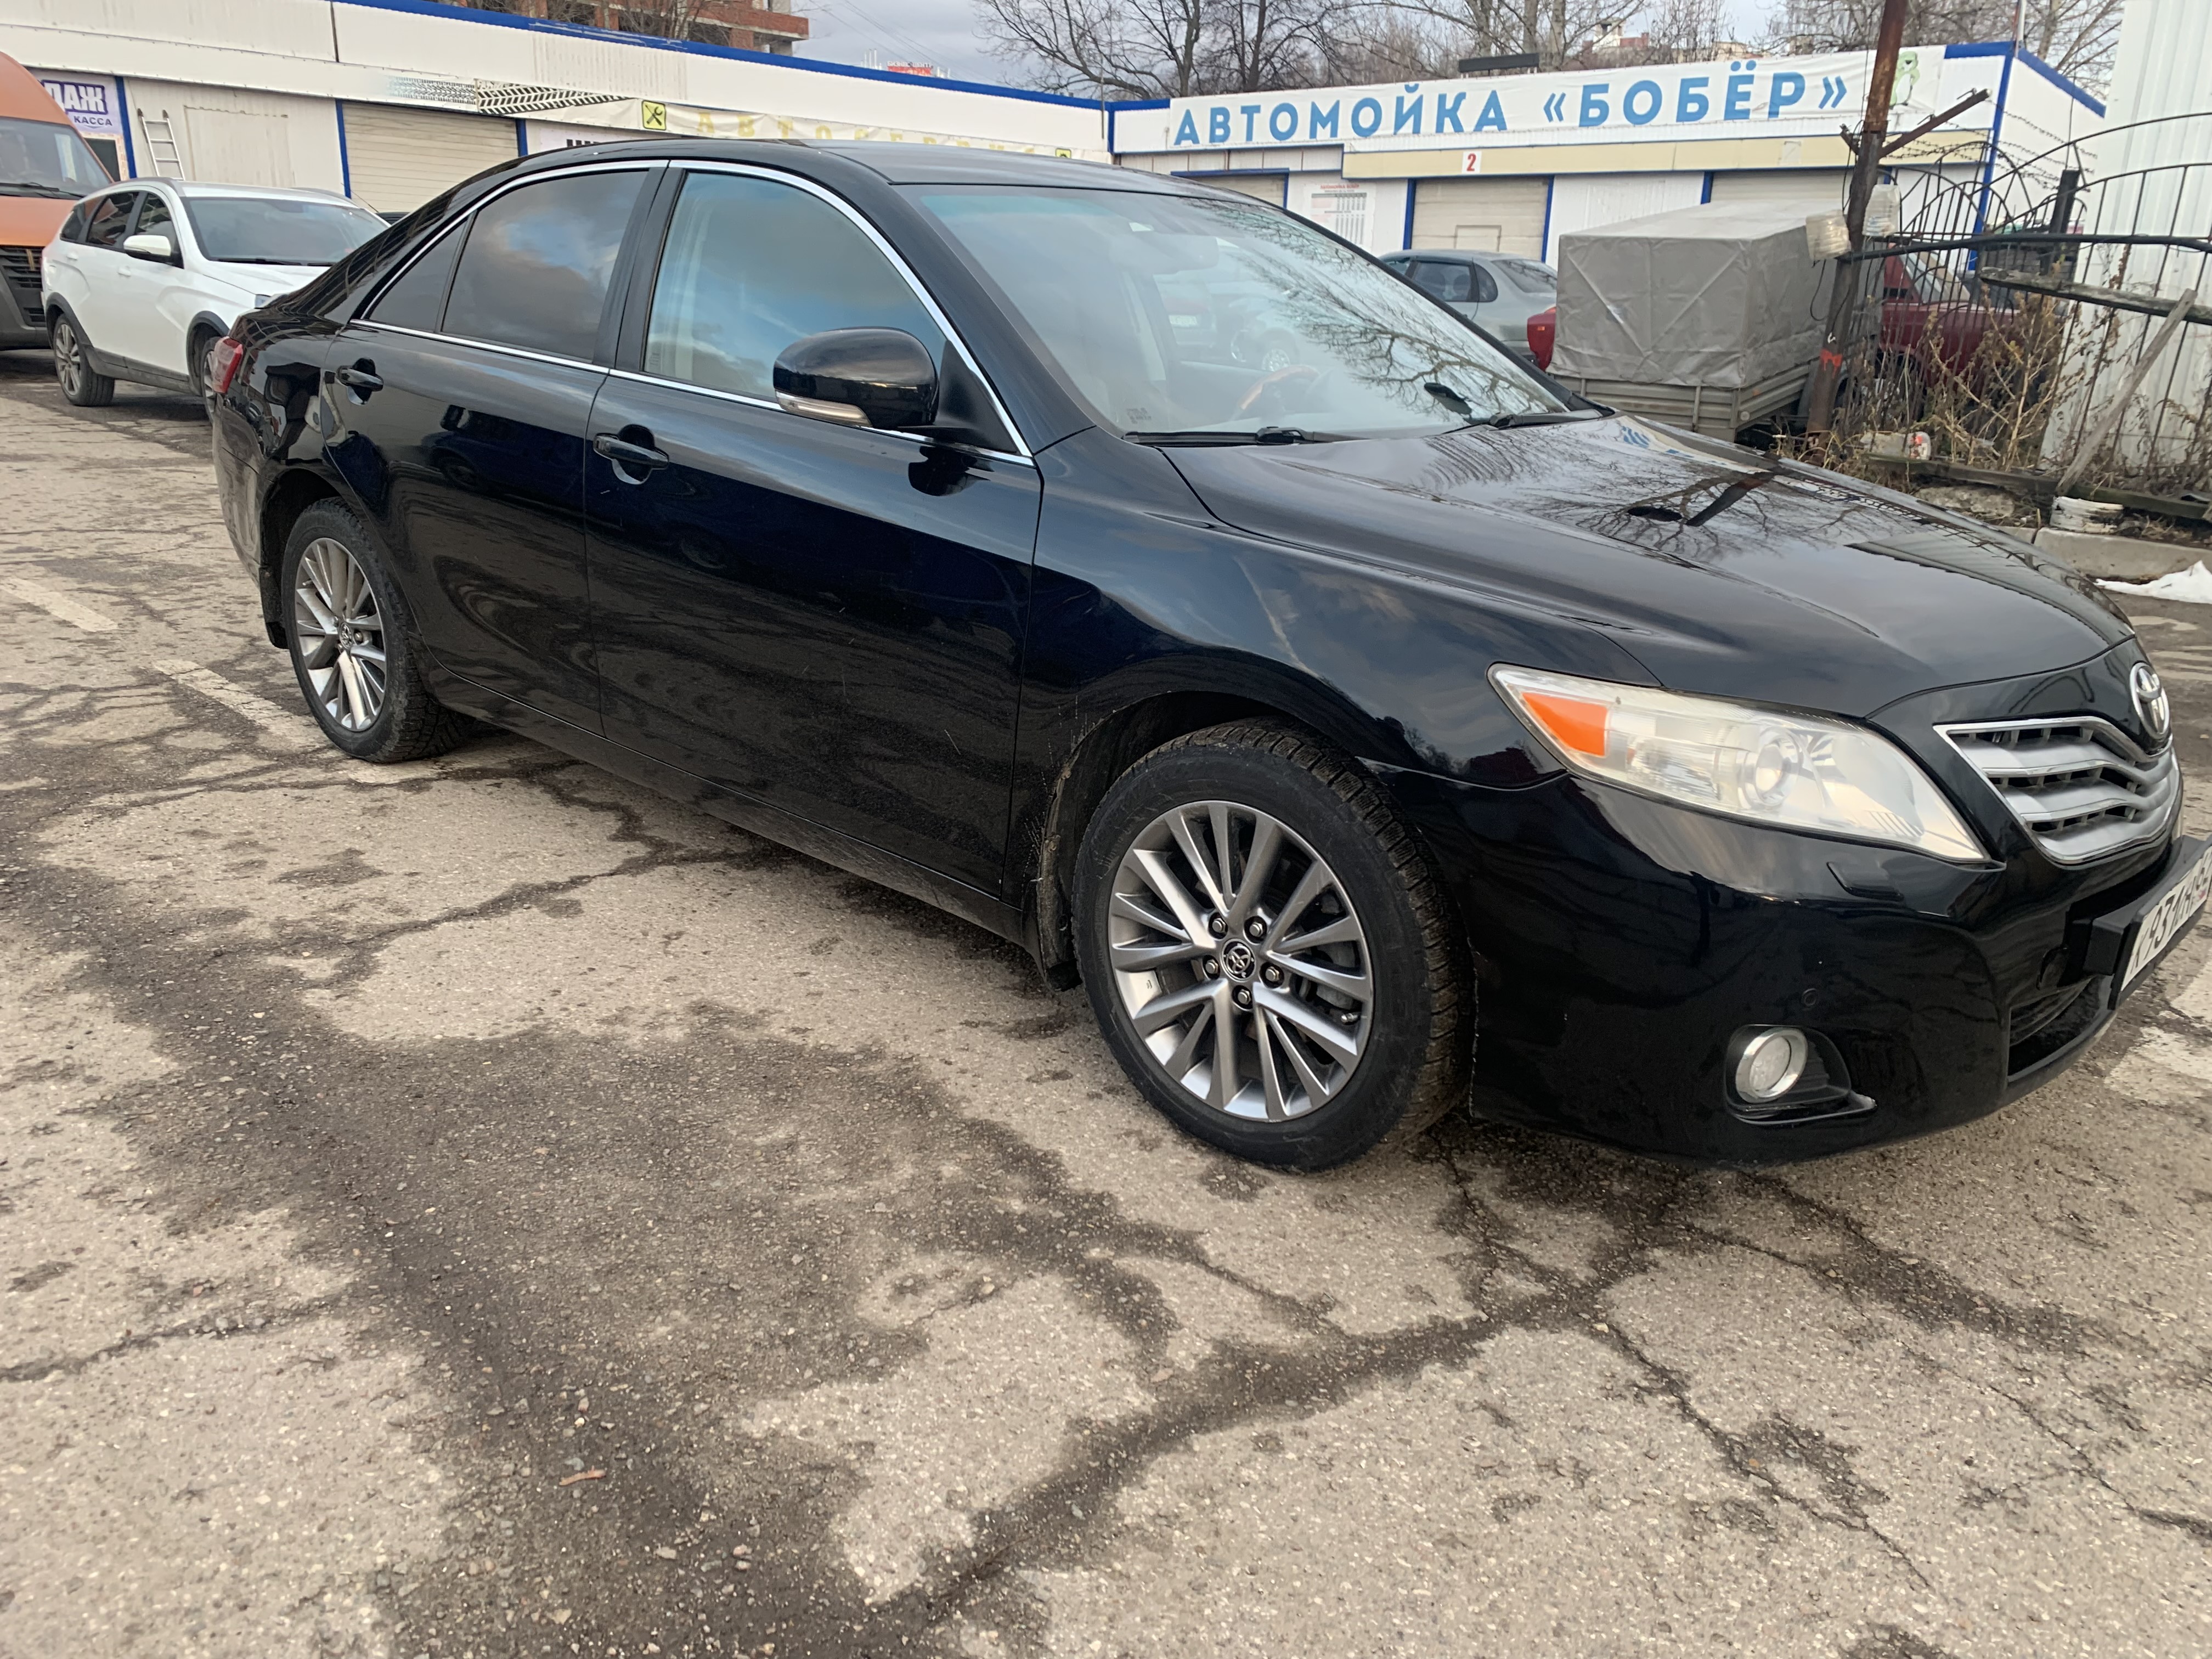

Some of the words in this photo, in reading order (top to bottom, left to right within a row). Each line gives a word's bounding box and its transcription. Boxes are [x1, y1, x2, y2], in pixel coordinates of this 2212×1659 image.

[1174, 83, 1508, 145] АВТОМОЙКА
[1543, 60, 1848, 128] «БОБЁР»
[73, 115, 113, 127] КАССА
[1466, 153, 1477, 171] 2
